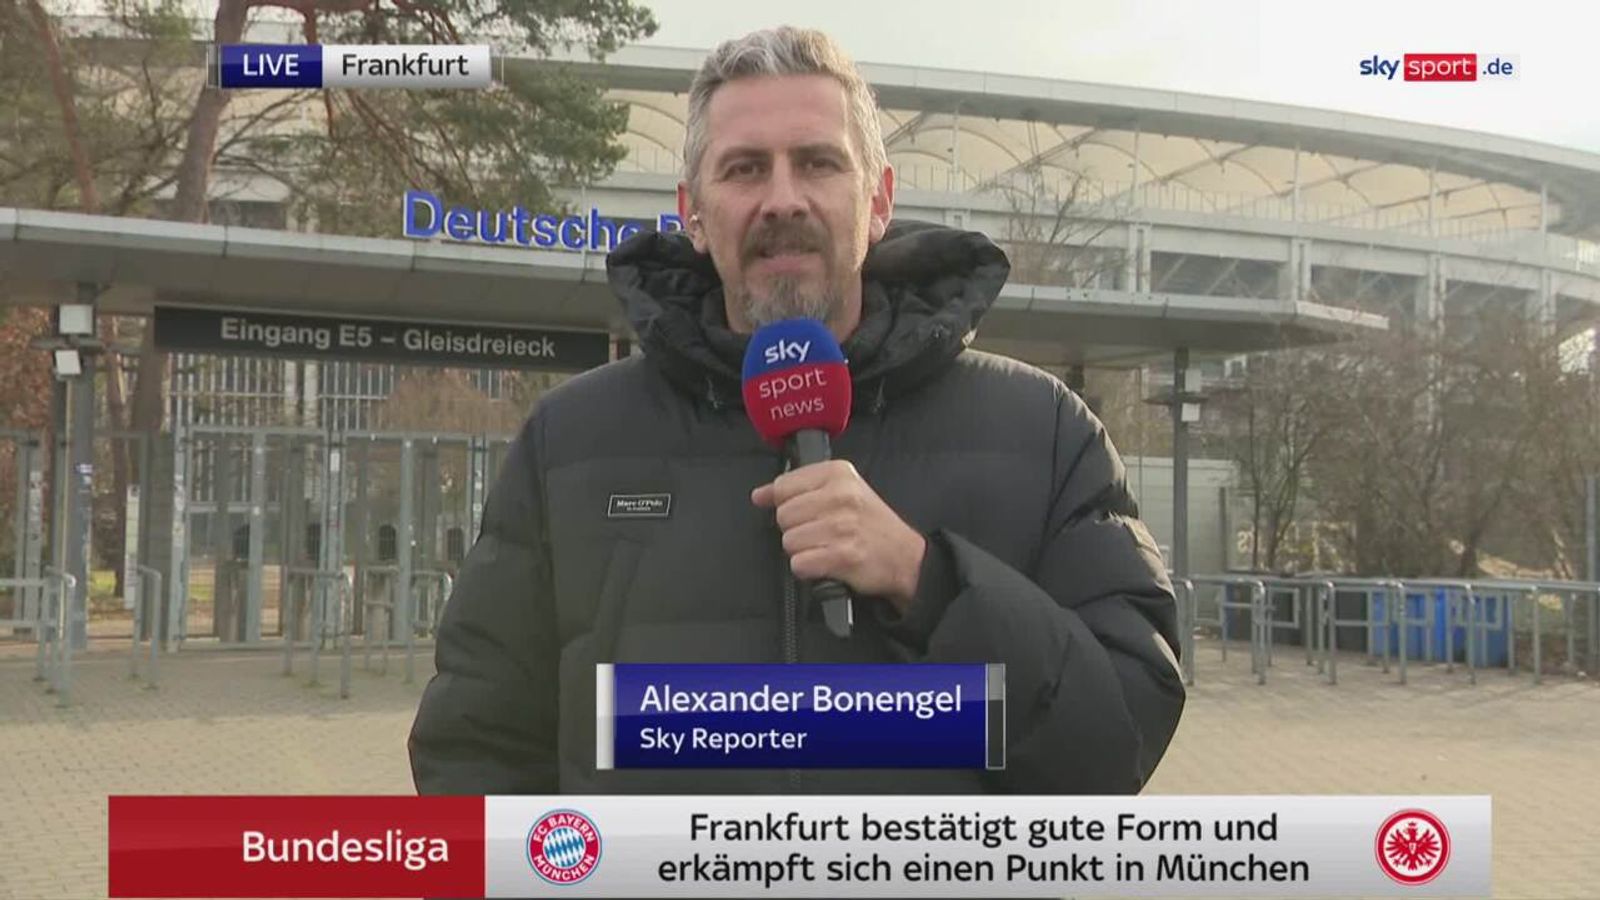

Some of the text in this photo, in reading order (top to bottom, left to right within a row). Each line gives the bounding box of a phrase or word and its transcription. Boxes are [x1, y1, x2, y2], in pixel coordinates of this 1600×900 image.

[220, 316, 331, 350] Eingang
[338, 324, 373, 348] E5
[402, 327, 556, 358] Gleisdreieck
[764, 338, 811, 365] sky
[759, 367, 828, 400] sport
[769, 397, 825, 421] news
